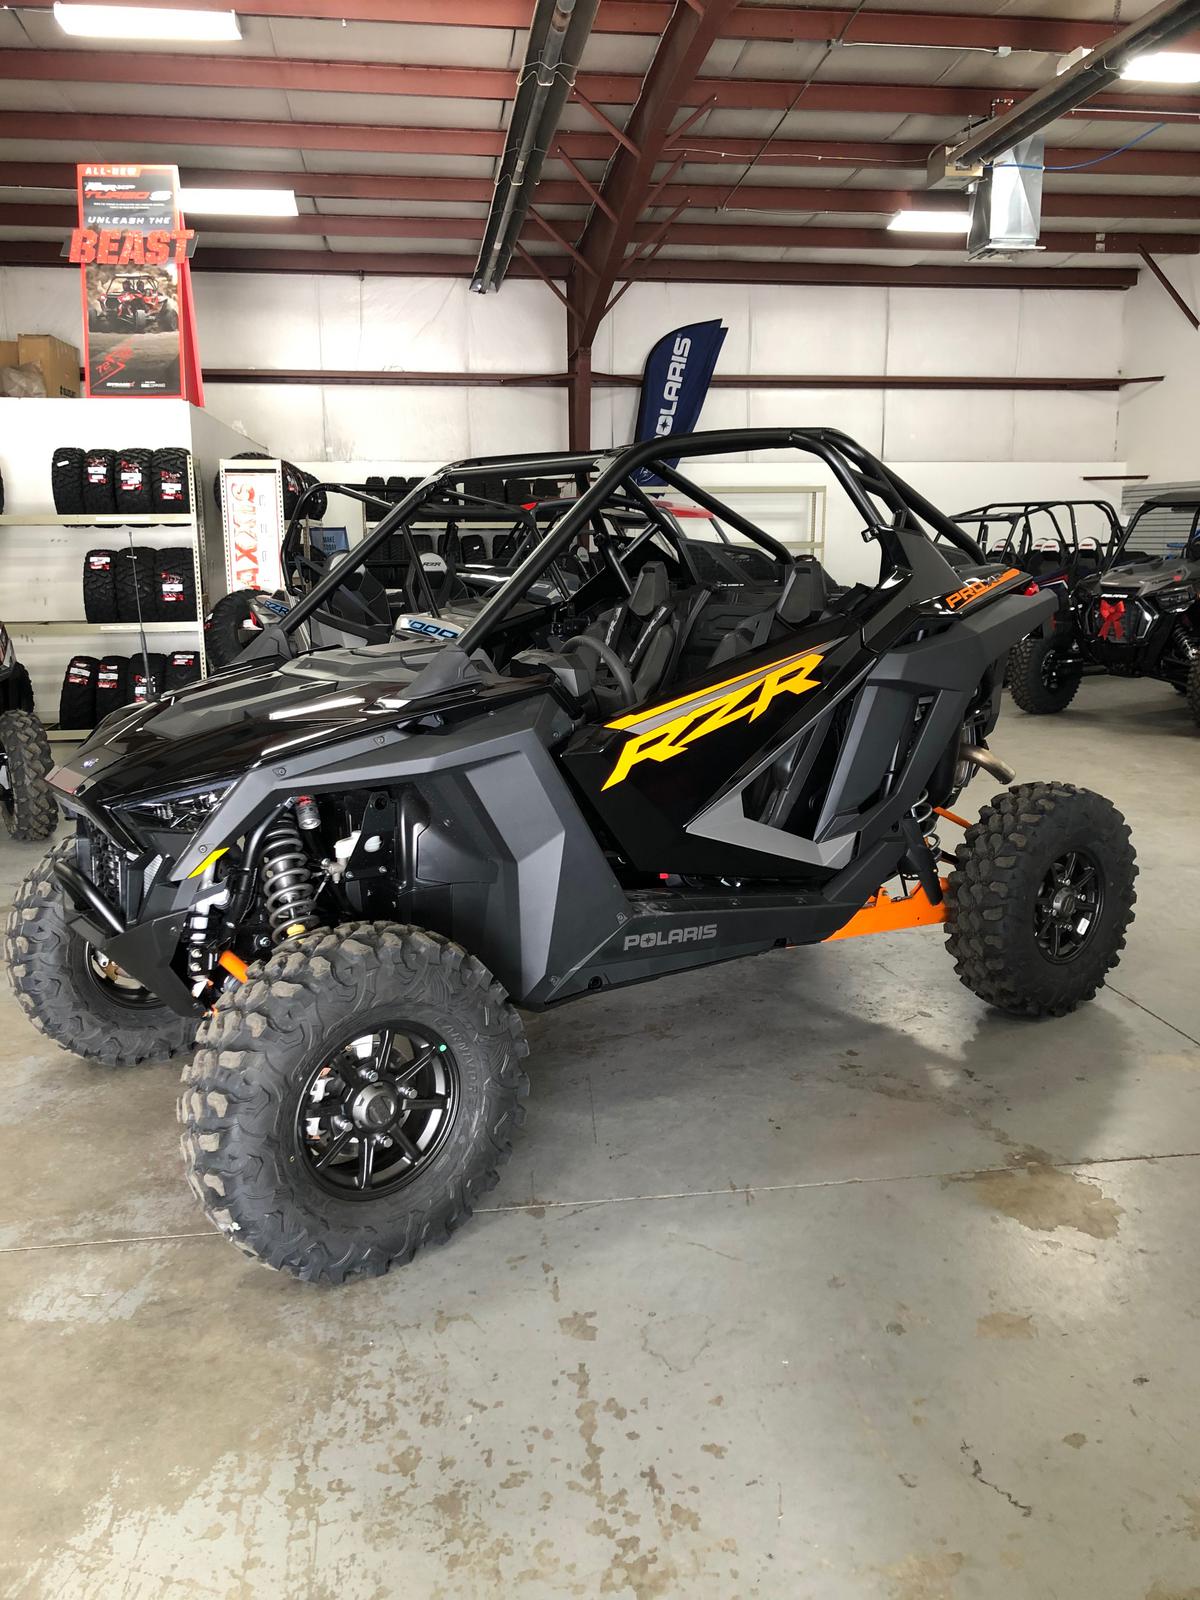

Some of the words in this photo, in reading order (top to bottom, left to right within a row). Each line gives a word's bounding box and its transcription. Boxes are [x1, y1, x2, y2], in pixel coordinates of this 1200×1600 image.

[85, 167, 137, 176] ALL-NEW
[87, 216, 145, 225] UNLEASH
[149, 217, 172, 225] THE
[69, 229, 195, 265] BEAST
[653, 337, 692, 439] OLARIS
[231, 482, 260, 591] AXXIS
[945, 581, 987, 609] PRO
[600, 653, 824, 792] RZR
[623, 923, 718, 951] POLARIS
